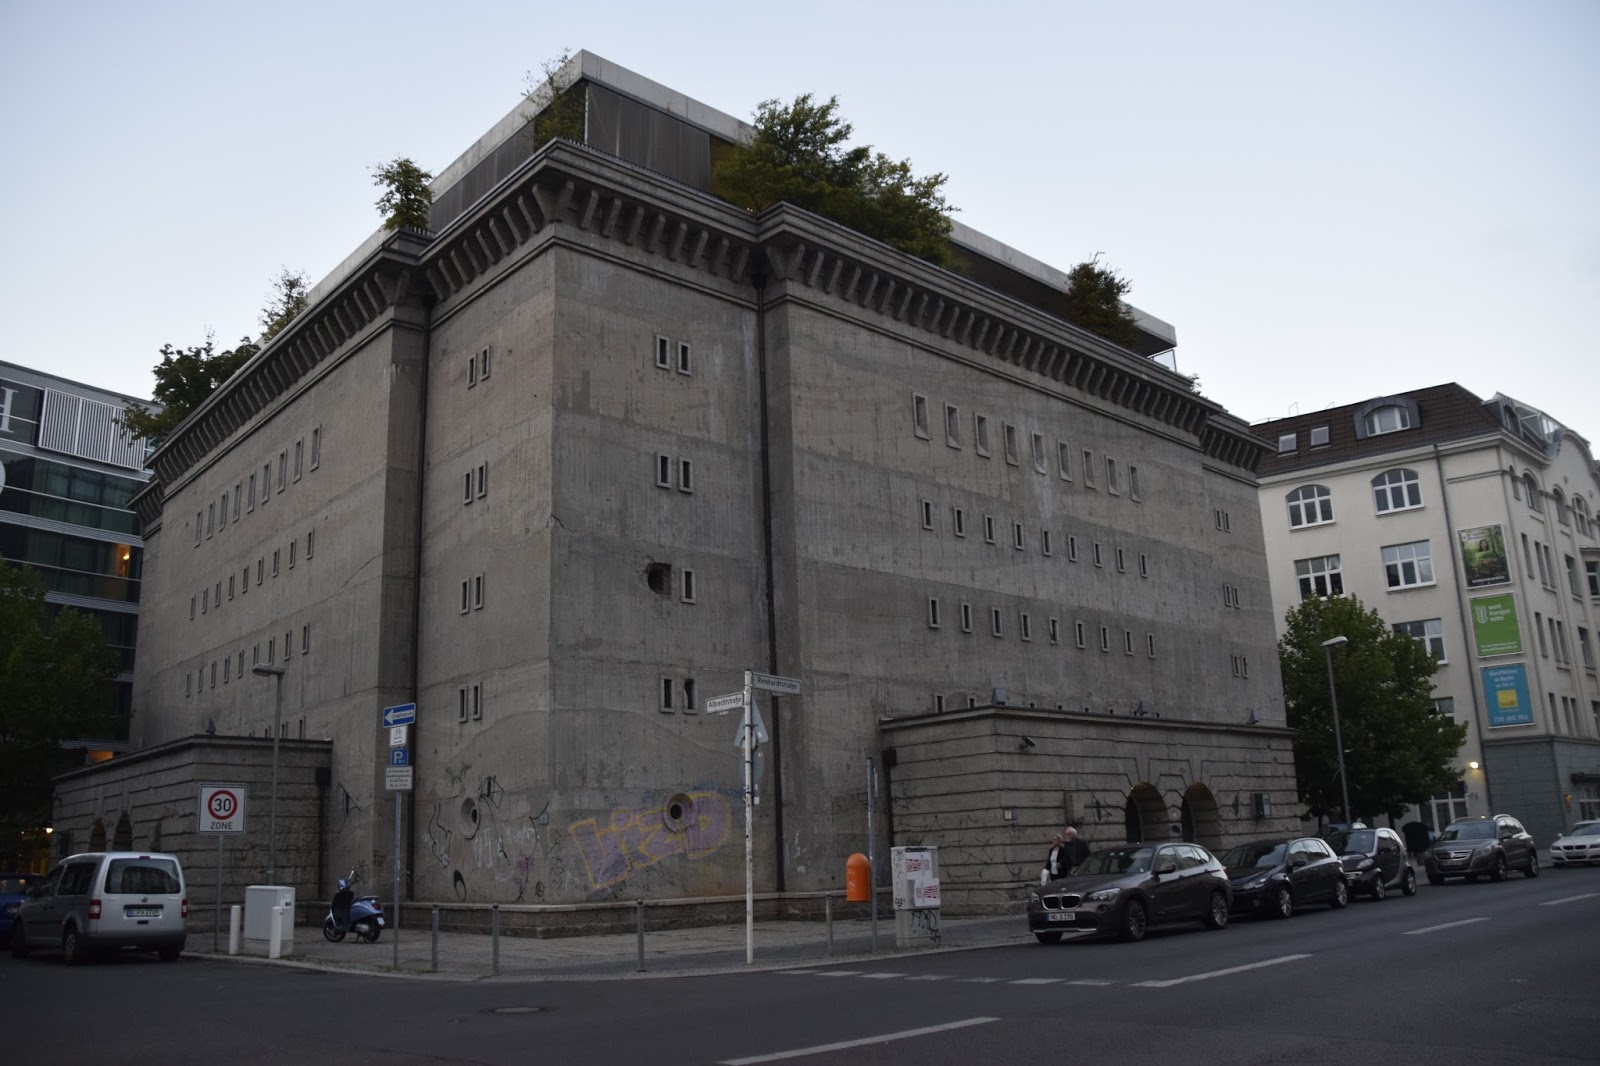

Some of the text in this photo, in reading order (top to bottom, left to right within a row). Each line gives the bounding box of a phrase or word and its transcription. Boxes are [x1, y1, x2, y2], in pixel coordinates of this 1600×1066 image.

[757, 676, 797, 690] Reinhardtstraße
[709, 696, 742, 707] Albrechtstraße
[394, 751, 403, 763] P
[214, 798, 231, 812] 30
[210, 822, 233, 830] ZONE
